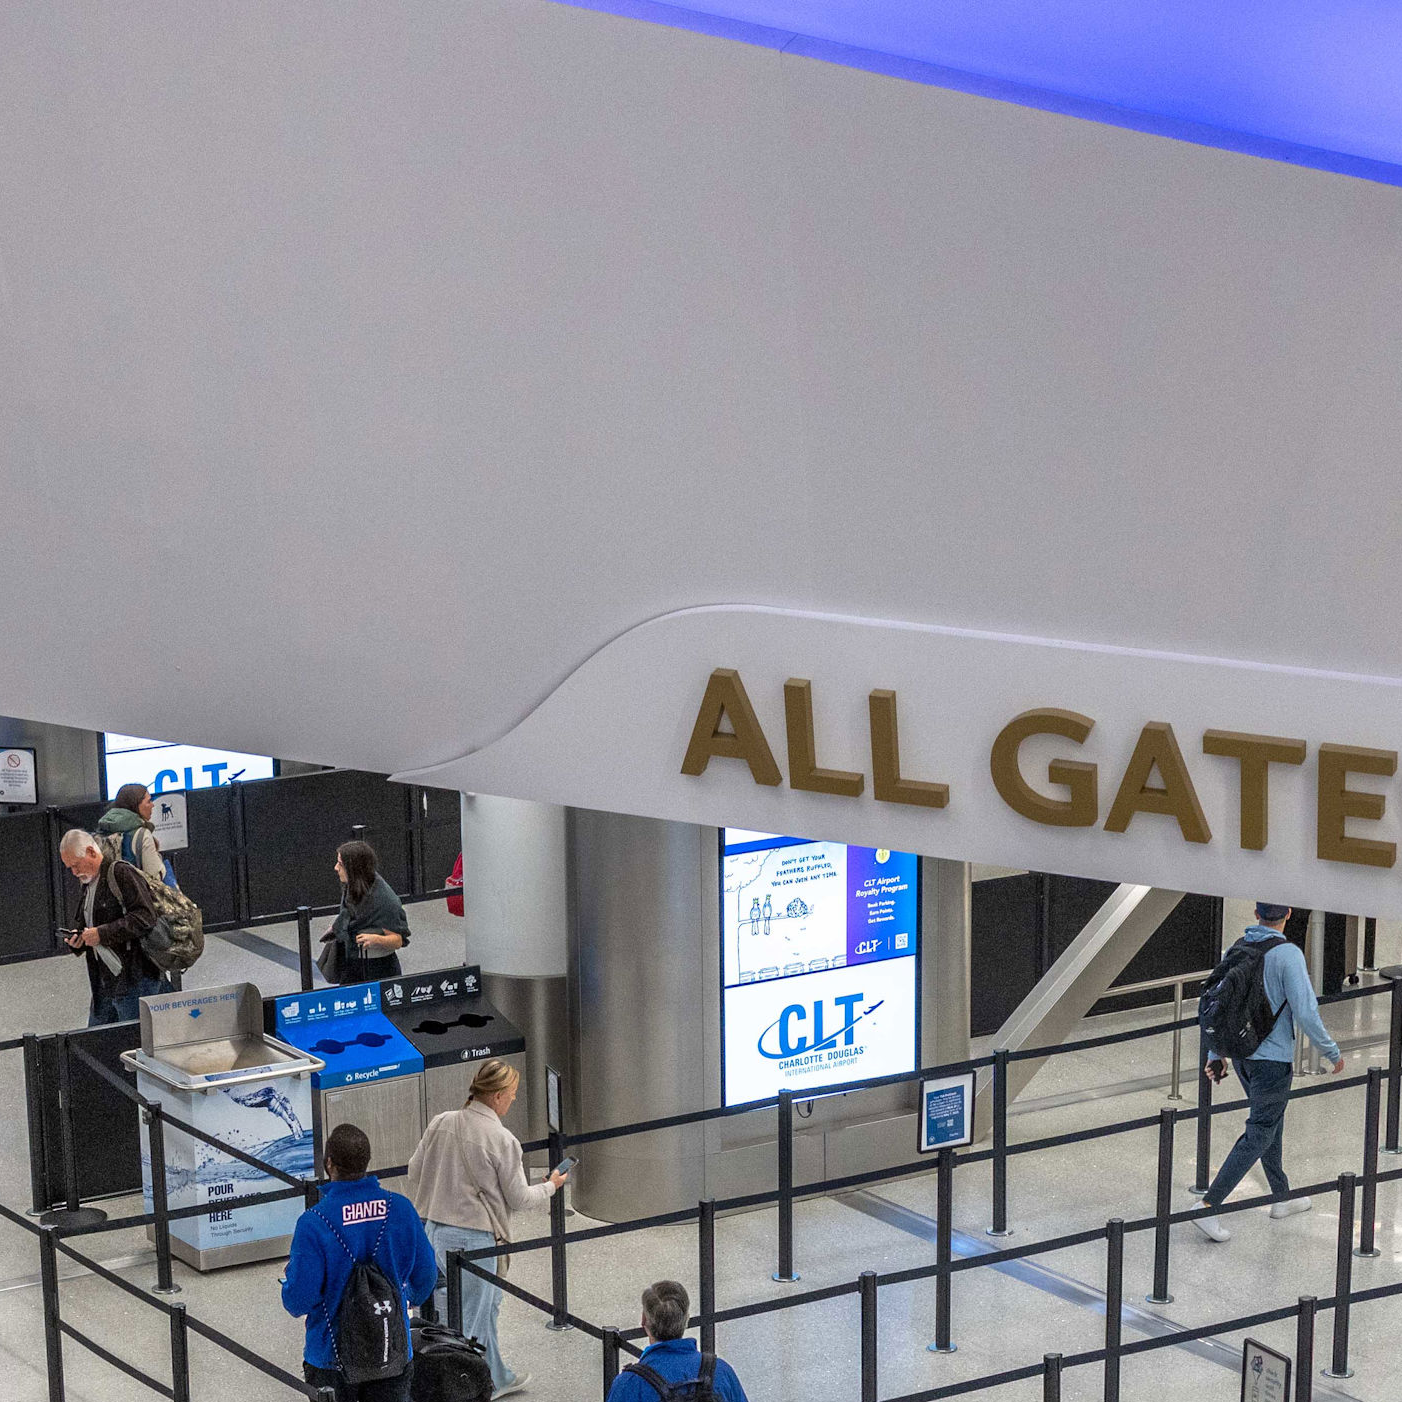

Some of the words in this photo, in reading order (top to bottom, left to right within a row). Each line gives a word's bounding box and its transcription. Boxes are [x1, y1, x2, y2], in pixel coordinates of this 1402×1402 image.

[680, 667, 950, 808] ALL
[776, 867, 805, 877] FEATHERS
[795, 876, 808, 884] JOIN
[810, 873, 821, 881] ANY
[863, 878, 877, 887] CLT
[877, 875, 901, 886] Airport
[855, 887, 880, 898] Royalty
[881, 883, 909, 894] Program
[857, 939, 880, 954] CLT
[149, 1003, 170, 1012] POUR
[171, 996, 218, 1009] BEVERAGES
[778, 992, 864, 1056] CLT
[471, 1046, 491, 1058] Trash
[778, 1053, 823, 1070] CHARLOTTE
[827, 1046, 864, 1061] DOUGLAS
[784, 1063, 832, 1077] INTERNATIONAL
[832, 1057, 858, 1069] AIRPORT
[354, 1068, 379, 1081] Recycle
[207, 1183, 234, 1197] POUR
[209, 1210, 233, 1223] HERE
[342, 1199, 387, 1222] GIANTS
[211, 1230, 232, 1238] Through
[233, 1226, 254, 1234] Security
[219, 1222, 238, 1230] Liquids
